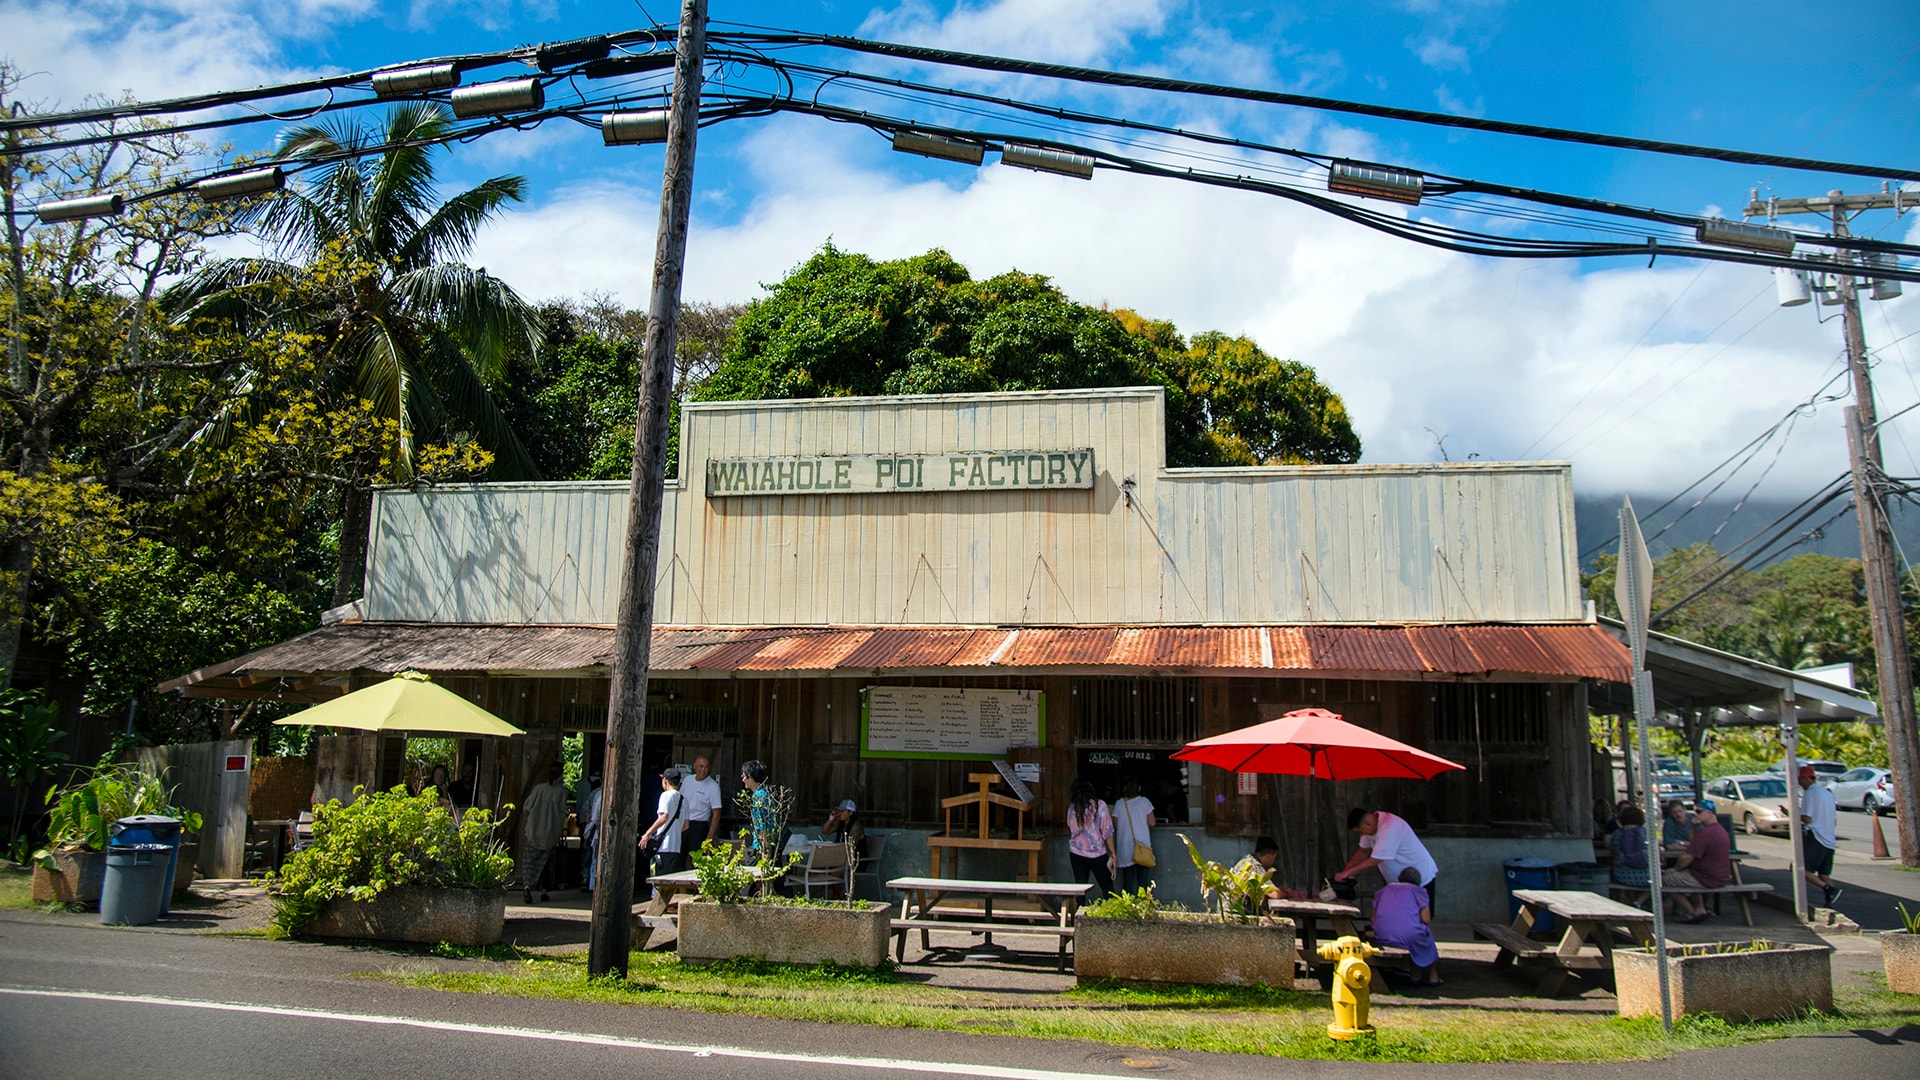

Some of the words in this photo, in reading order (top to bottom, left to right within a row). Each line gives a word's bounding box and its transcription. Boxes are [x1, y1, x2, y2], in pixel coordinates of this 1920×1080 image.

[711, 459, 852, 492] WAIAHOLE
[875, 458, 925, 488] POI
[948, 453, 1089, 487] FACTORY
